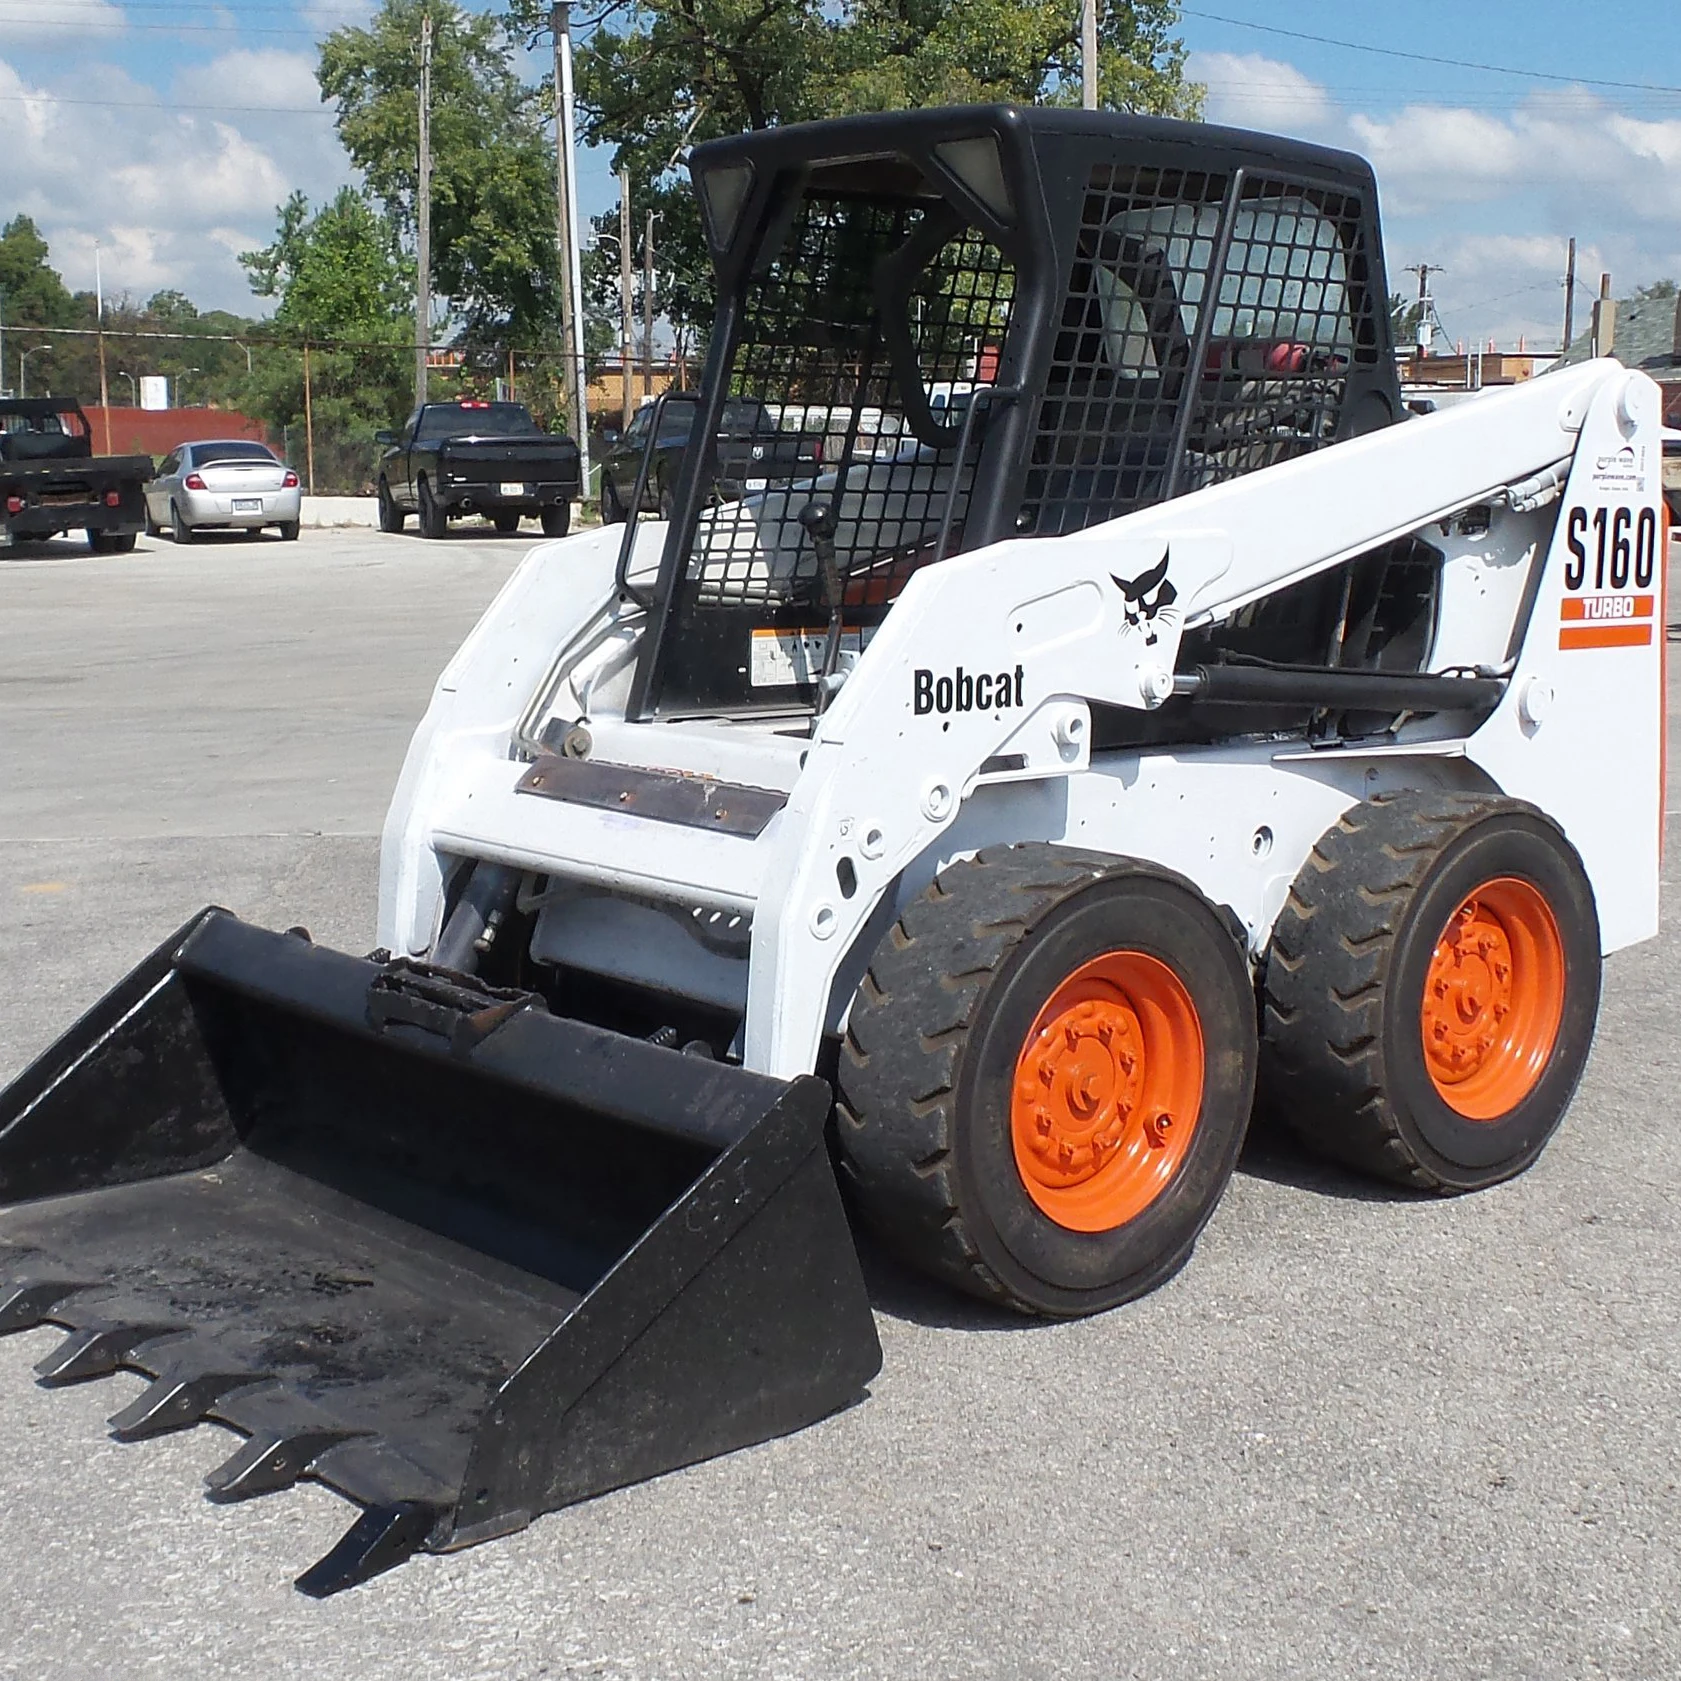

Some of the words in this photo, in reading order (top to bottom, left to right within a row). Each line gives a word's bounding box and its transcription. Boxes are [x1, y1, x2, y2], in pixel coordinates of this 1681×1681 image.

[1564, 506, 1656, 591] S160
[1582, 596, 1635, 619] TURBO
[913, 664, 1024, 716] Bobcat
